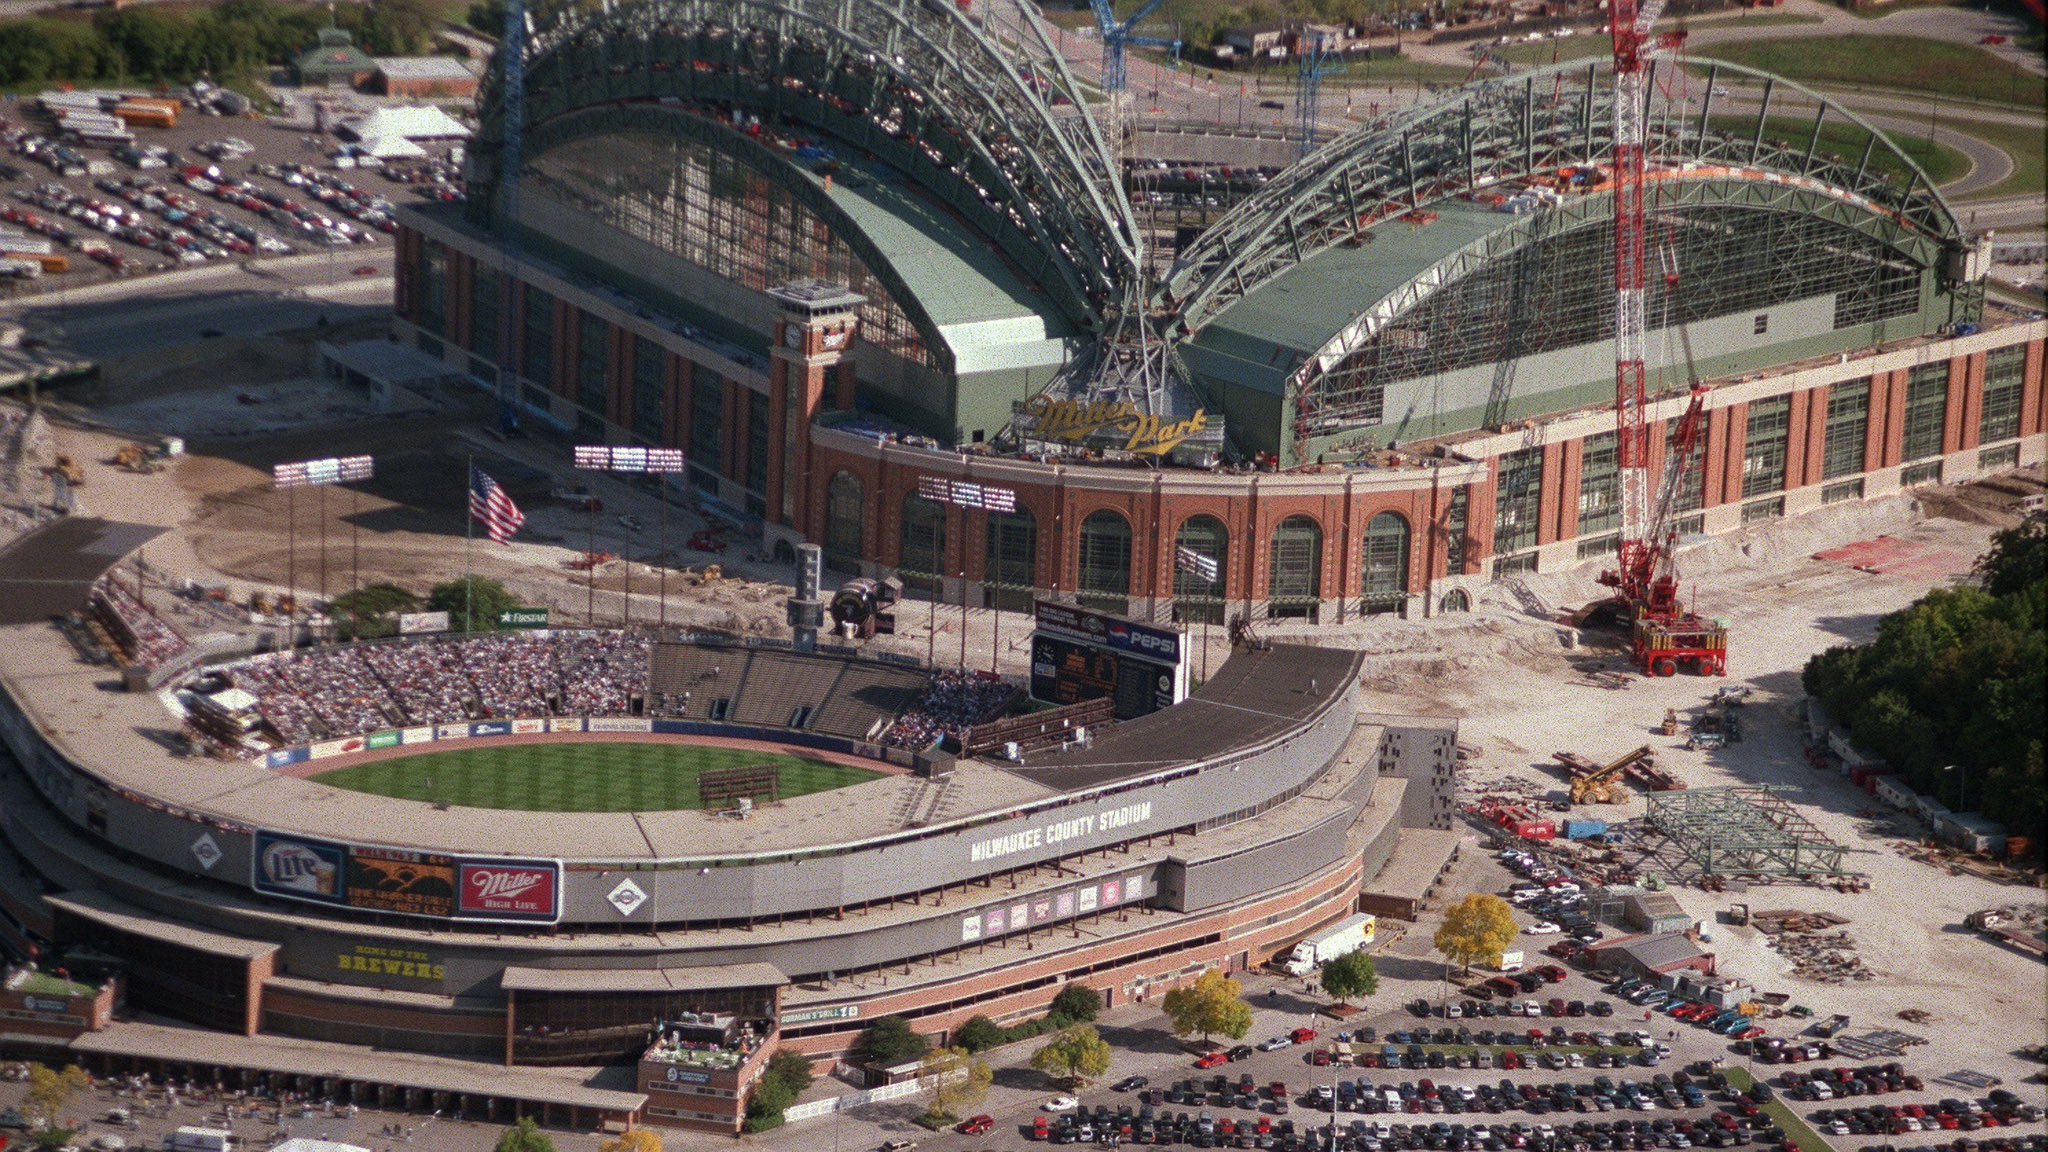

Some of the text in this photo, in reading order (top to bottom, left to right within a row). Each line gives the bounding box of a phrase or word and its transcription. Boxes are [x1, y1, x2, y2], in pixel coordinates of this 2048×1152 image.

[1024, 394, 1136, 433] Miller
[1118, 408, 1207, 450] Park
[513, 612, 547, 622] FIRSTAR
[1130, 631, 1175, 654] PEPSI
[971, 801, 1151, 862] MILWAUKEE COUNTY STADIUM
[272, 853, 317, 882] Lite
[472, 871, 543, 897] Miller
[485, 899, 537, 910] HIGH LIFE
[338, 954, 446, 980] BREWERS
